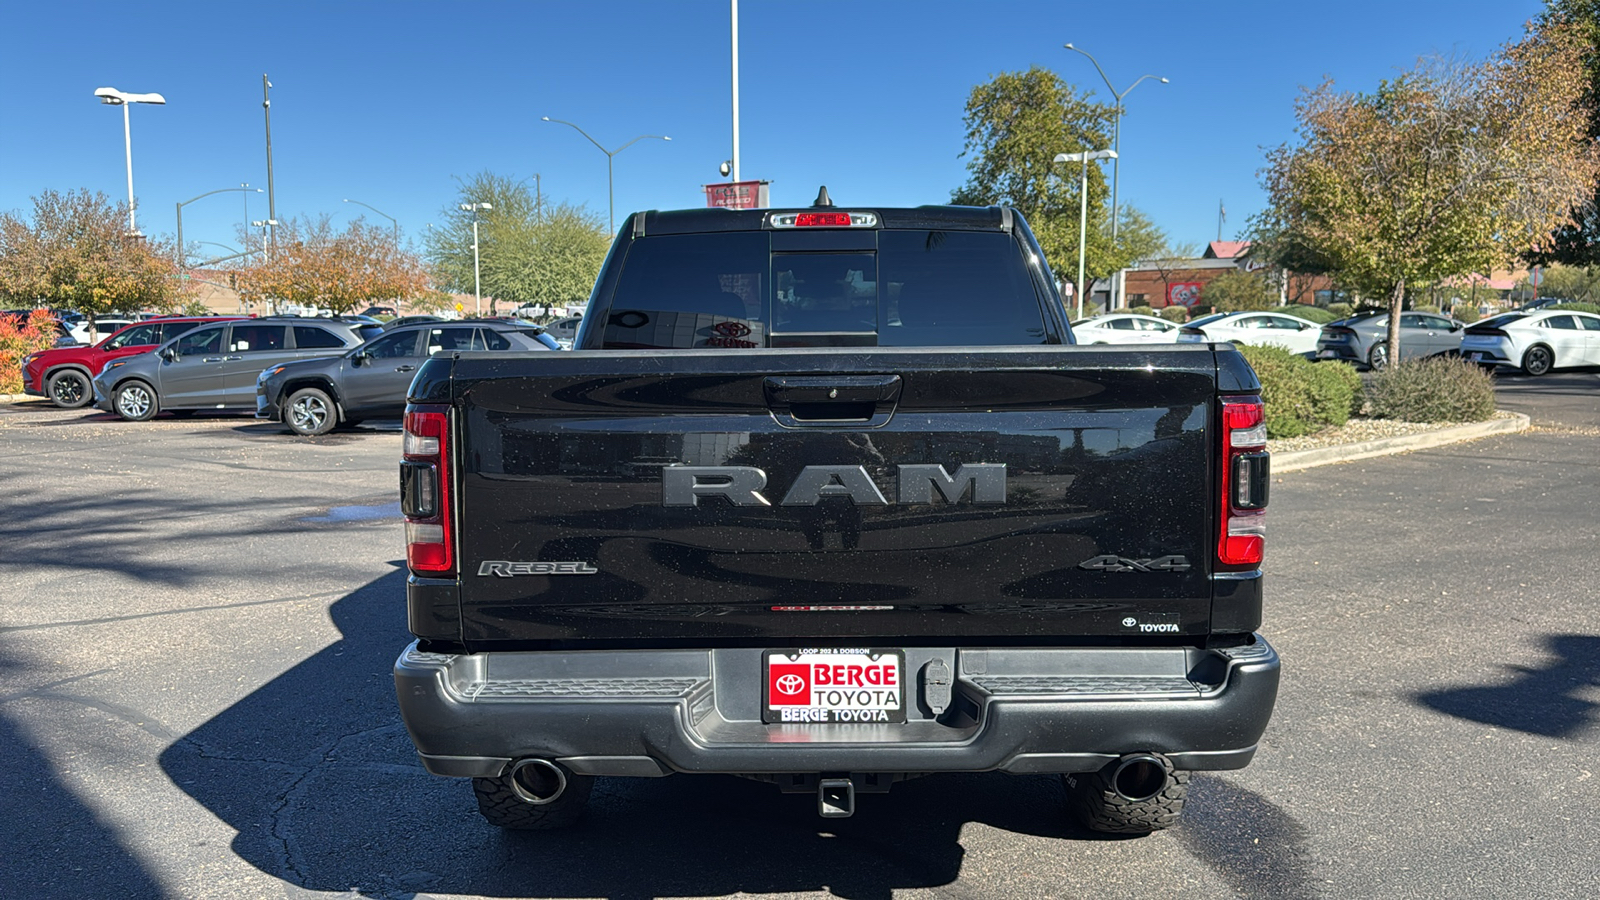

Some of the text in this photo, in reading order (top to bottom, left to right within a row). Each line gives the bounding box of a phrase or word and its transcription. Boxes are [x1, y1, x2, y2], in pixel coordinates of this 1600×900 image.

[662, 462, 1007, 508] RAM
[477, 560, 598, 578] REBEL
[1138, 623, 1180, 633] TOYOTA
[813, 663, 897, 688] BERGE
[814, 690, 899, 706] TOYOTA
[780, 707, 889, 723] BERGE TOYOTA
